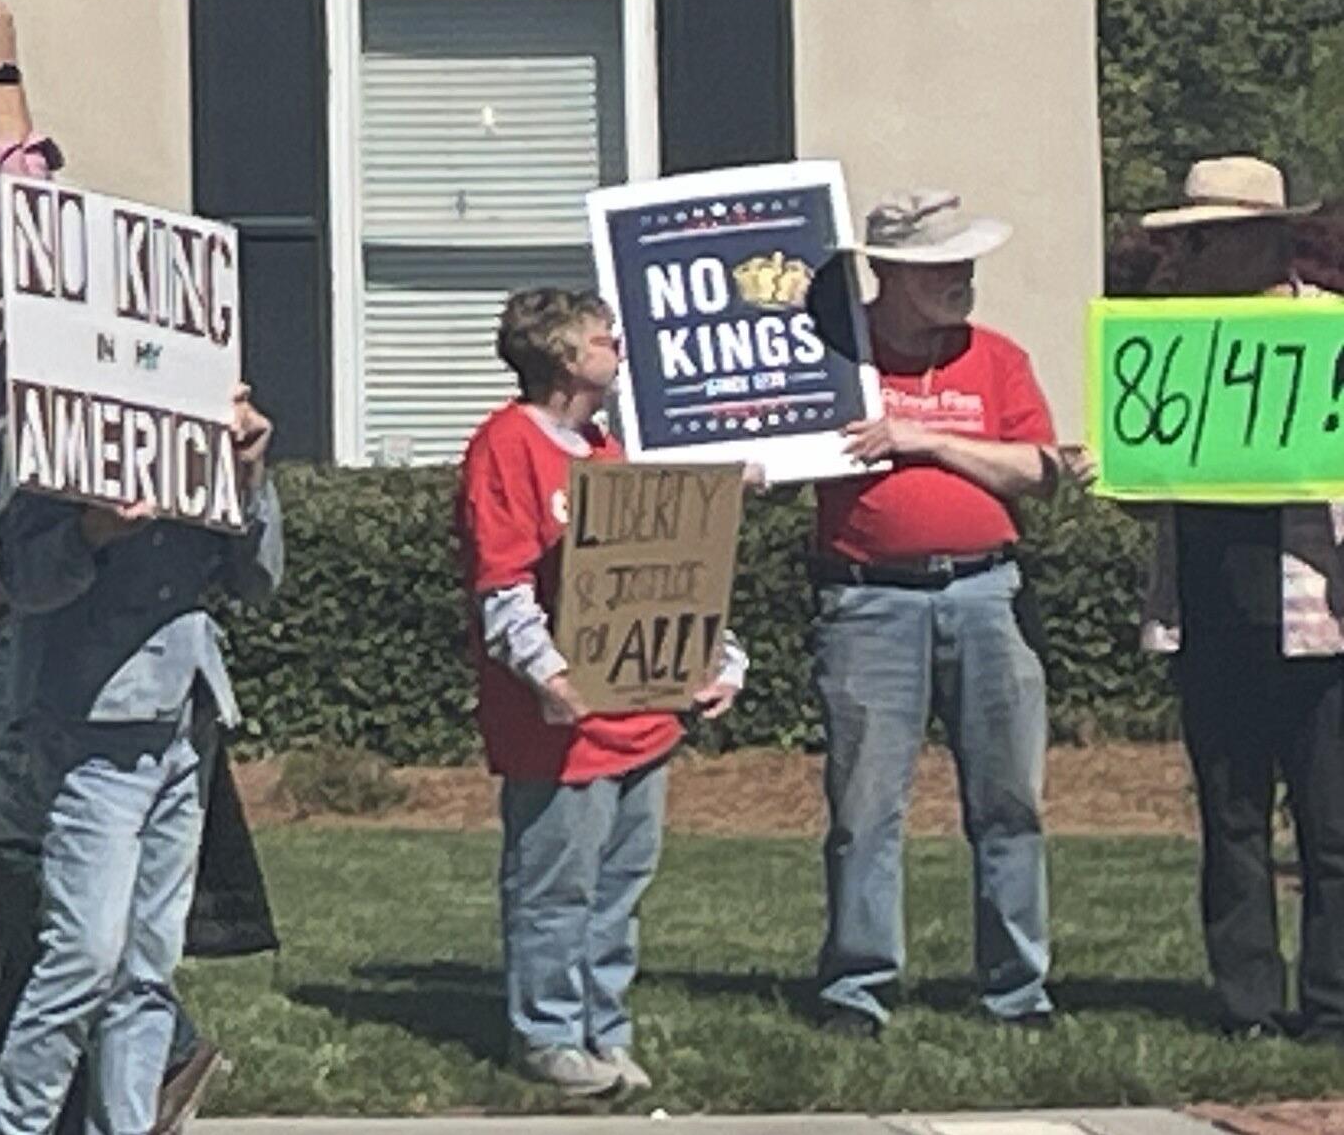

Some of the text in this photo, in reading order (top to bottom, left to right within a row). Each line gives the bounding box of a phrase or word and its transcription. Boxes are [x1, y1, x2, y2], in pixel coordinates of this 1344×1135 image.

[13, 184, 234, 348] NO KING
[645, 257, 730, 320] NO
[657, 312, 826, 379] KINGS
[13, 380, 245, 530] AMERICA
[576, 469, 724, 549] LIBERTY
